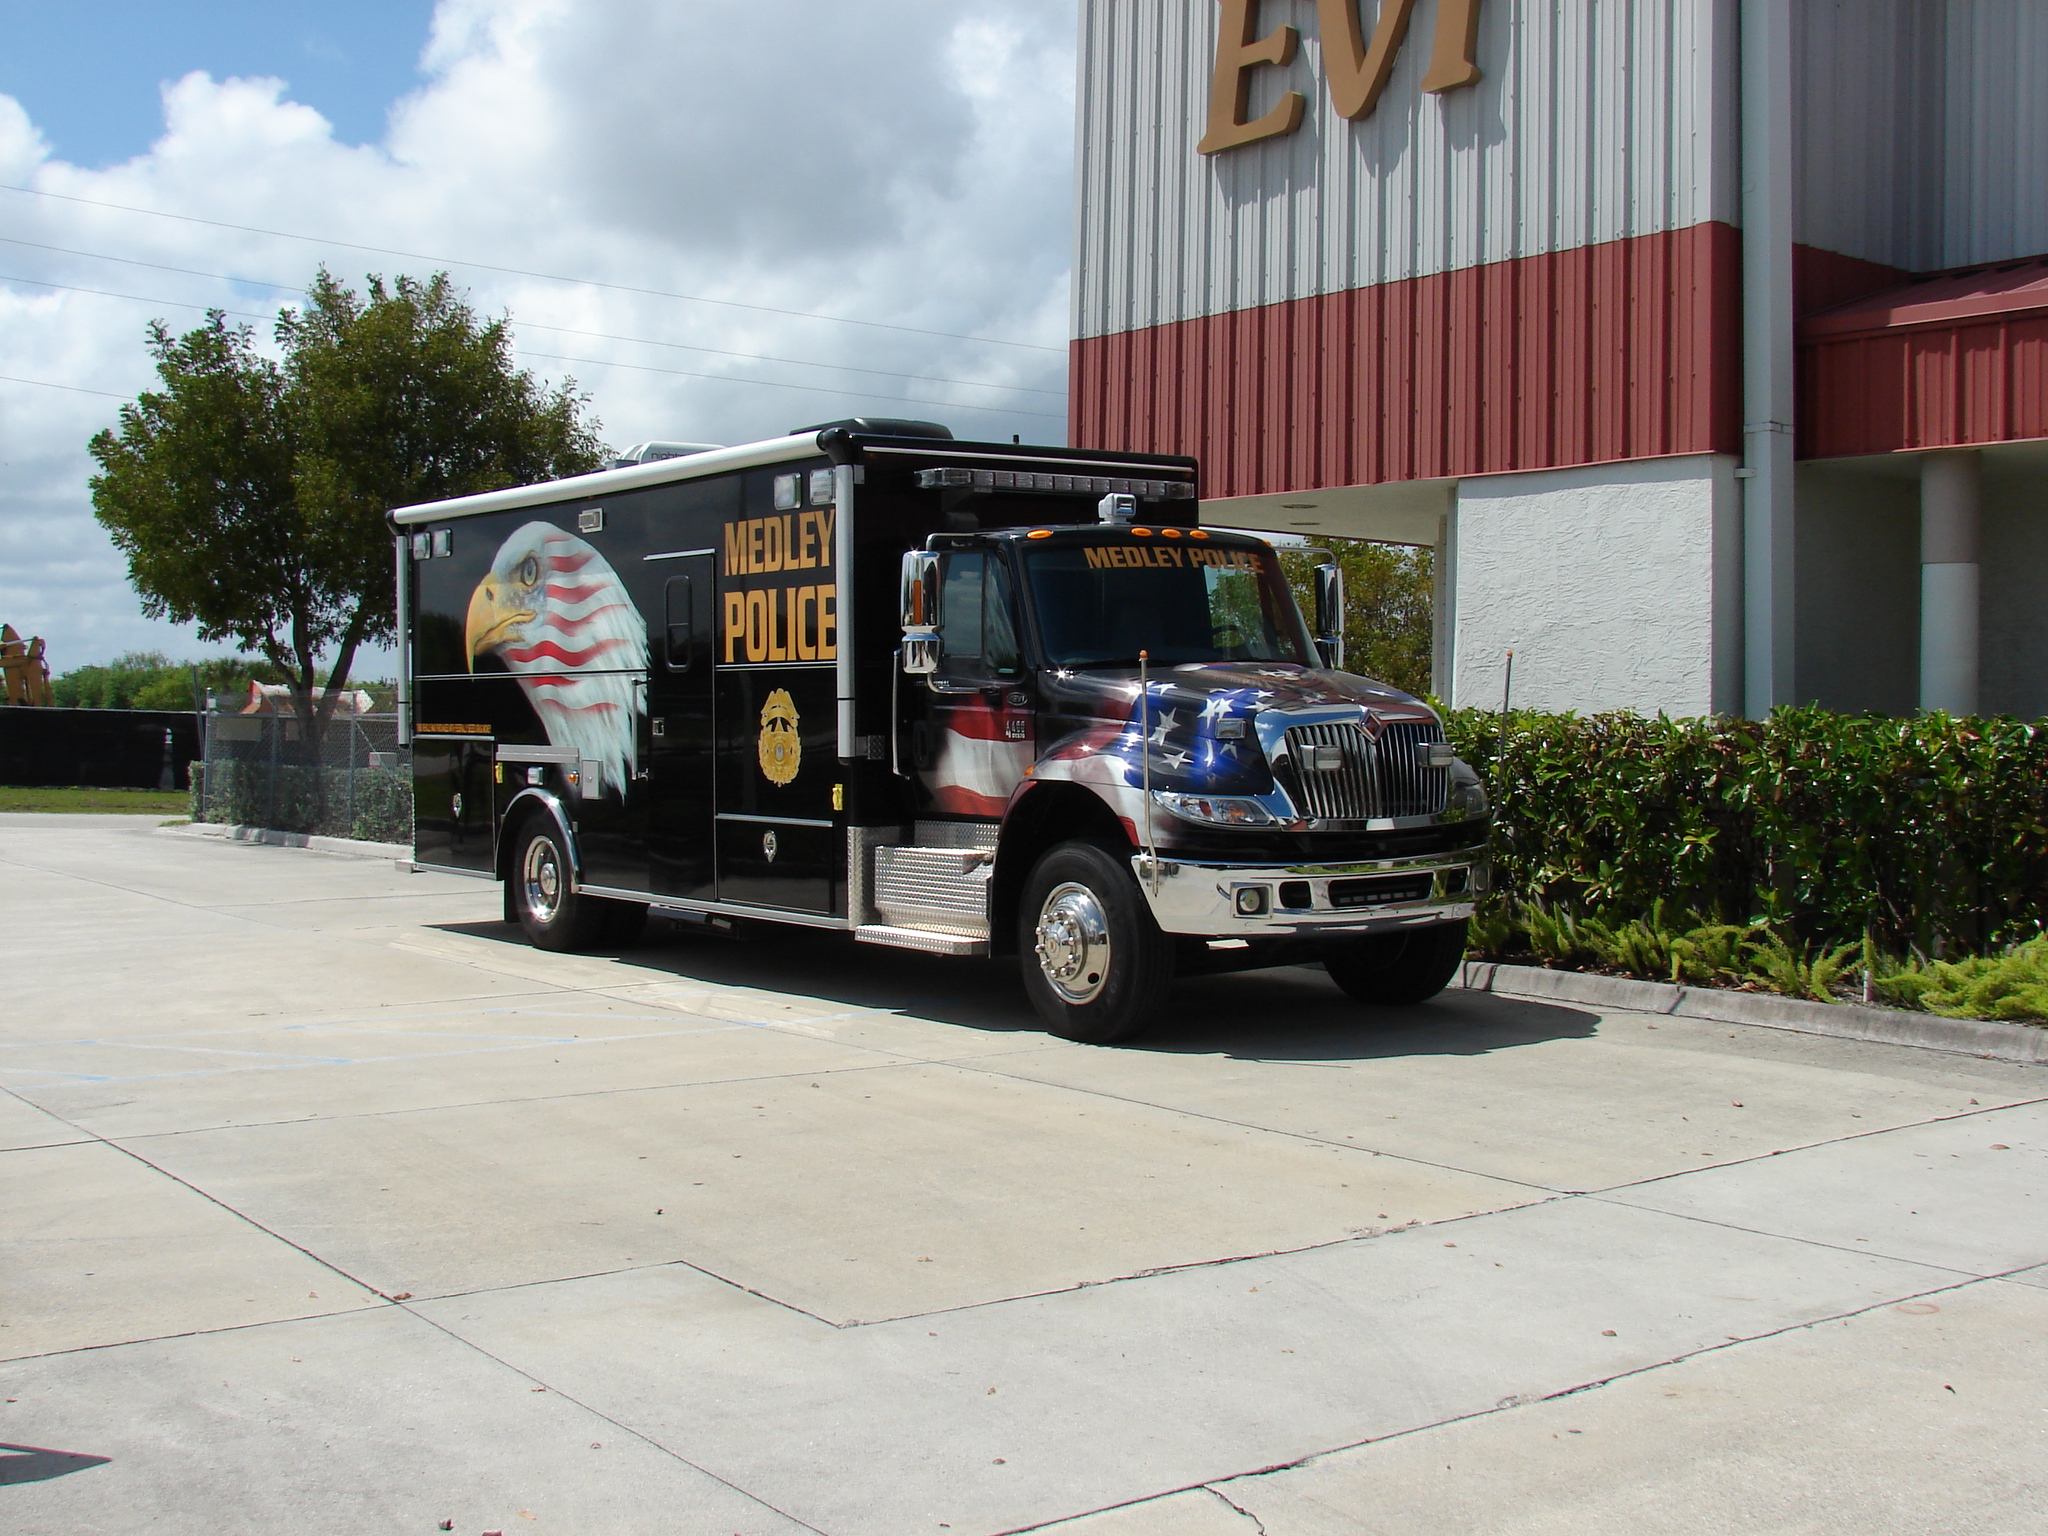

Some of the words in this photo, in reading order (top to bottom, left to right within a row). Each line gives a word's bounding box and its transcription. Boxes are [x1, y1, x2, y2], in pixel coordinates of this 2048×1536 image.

[1196, 0, 1482, 156] EVI
[724, 509, 836, 577] MEDLEY
[1083, 546, 1188, 569] MEDLEY
[1186, 547, 1265, 574] POLICE
[724, 583, 837, 663] POLICE
